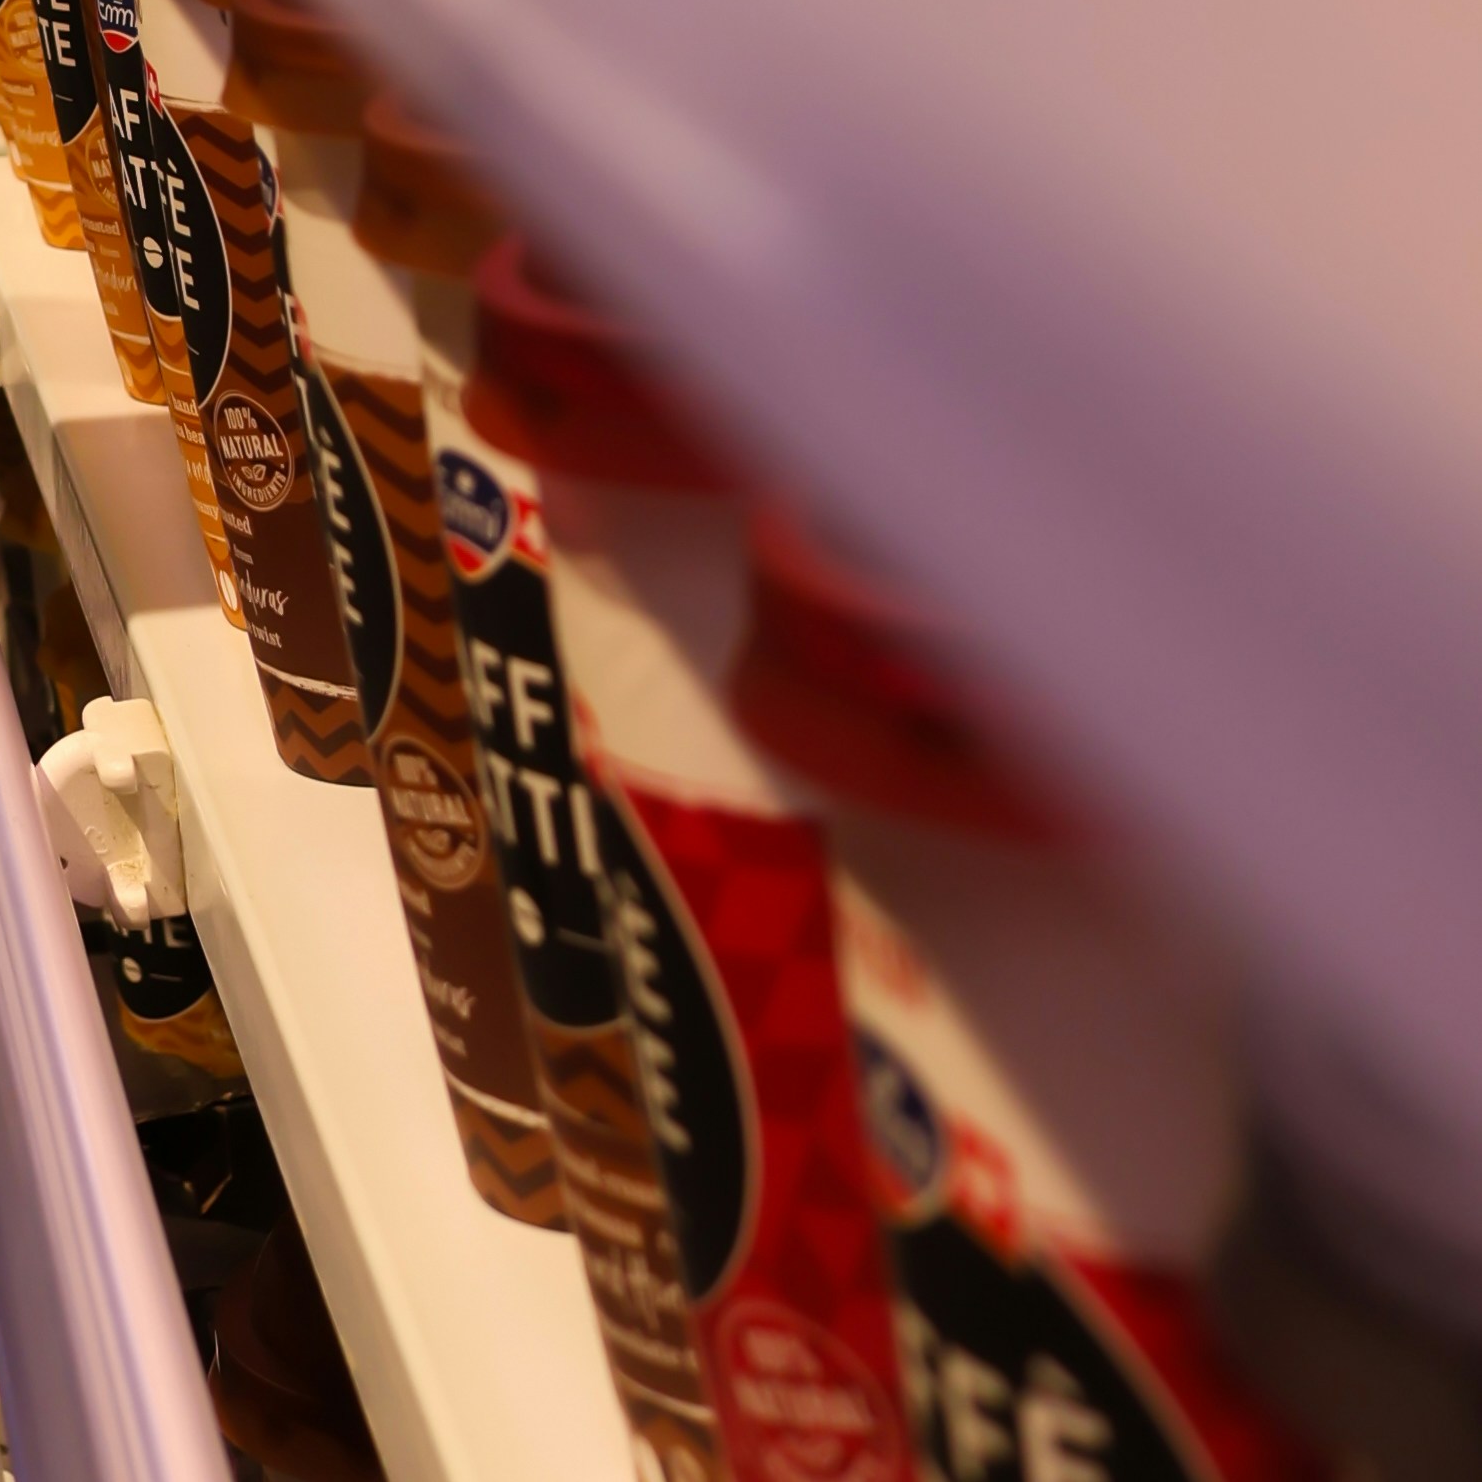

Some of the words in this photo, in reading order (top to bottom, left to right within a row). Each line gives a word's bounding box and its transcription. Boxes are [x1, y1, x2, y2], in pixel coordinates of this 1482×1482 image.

[223, 406, 258, 430] 100%
[219, 433, 284, 460] NATURAL
[232, 472, 287, 504] INGREDIENTS
